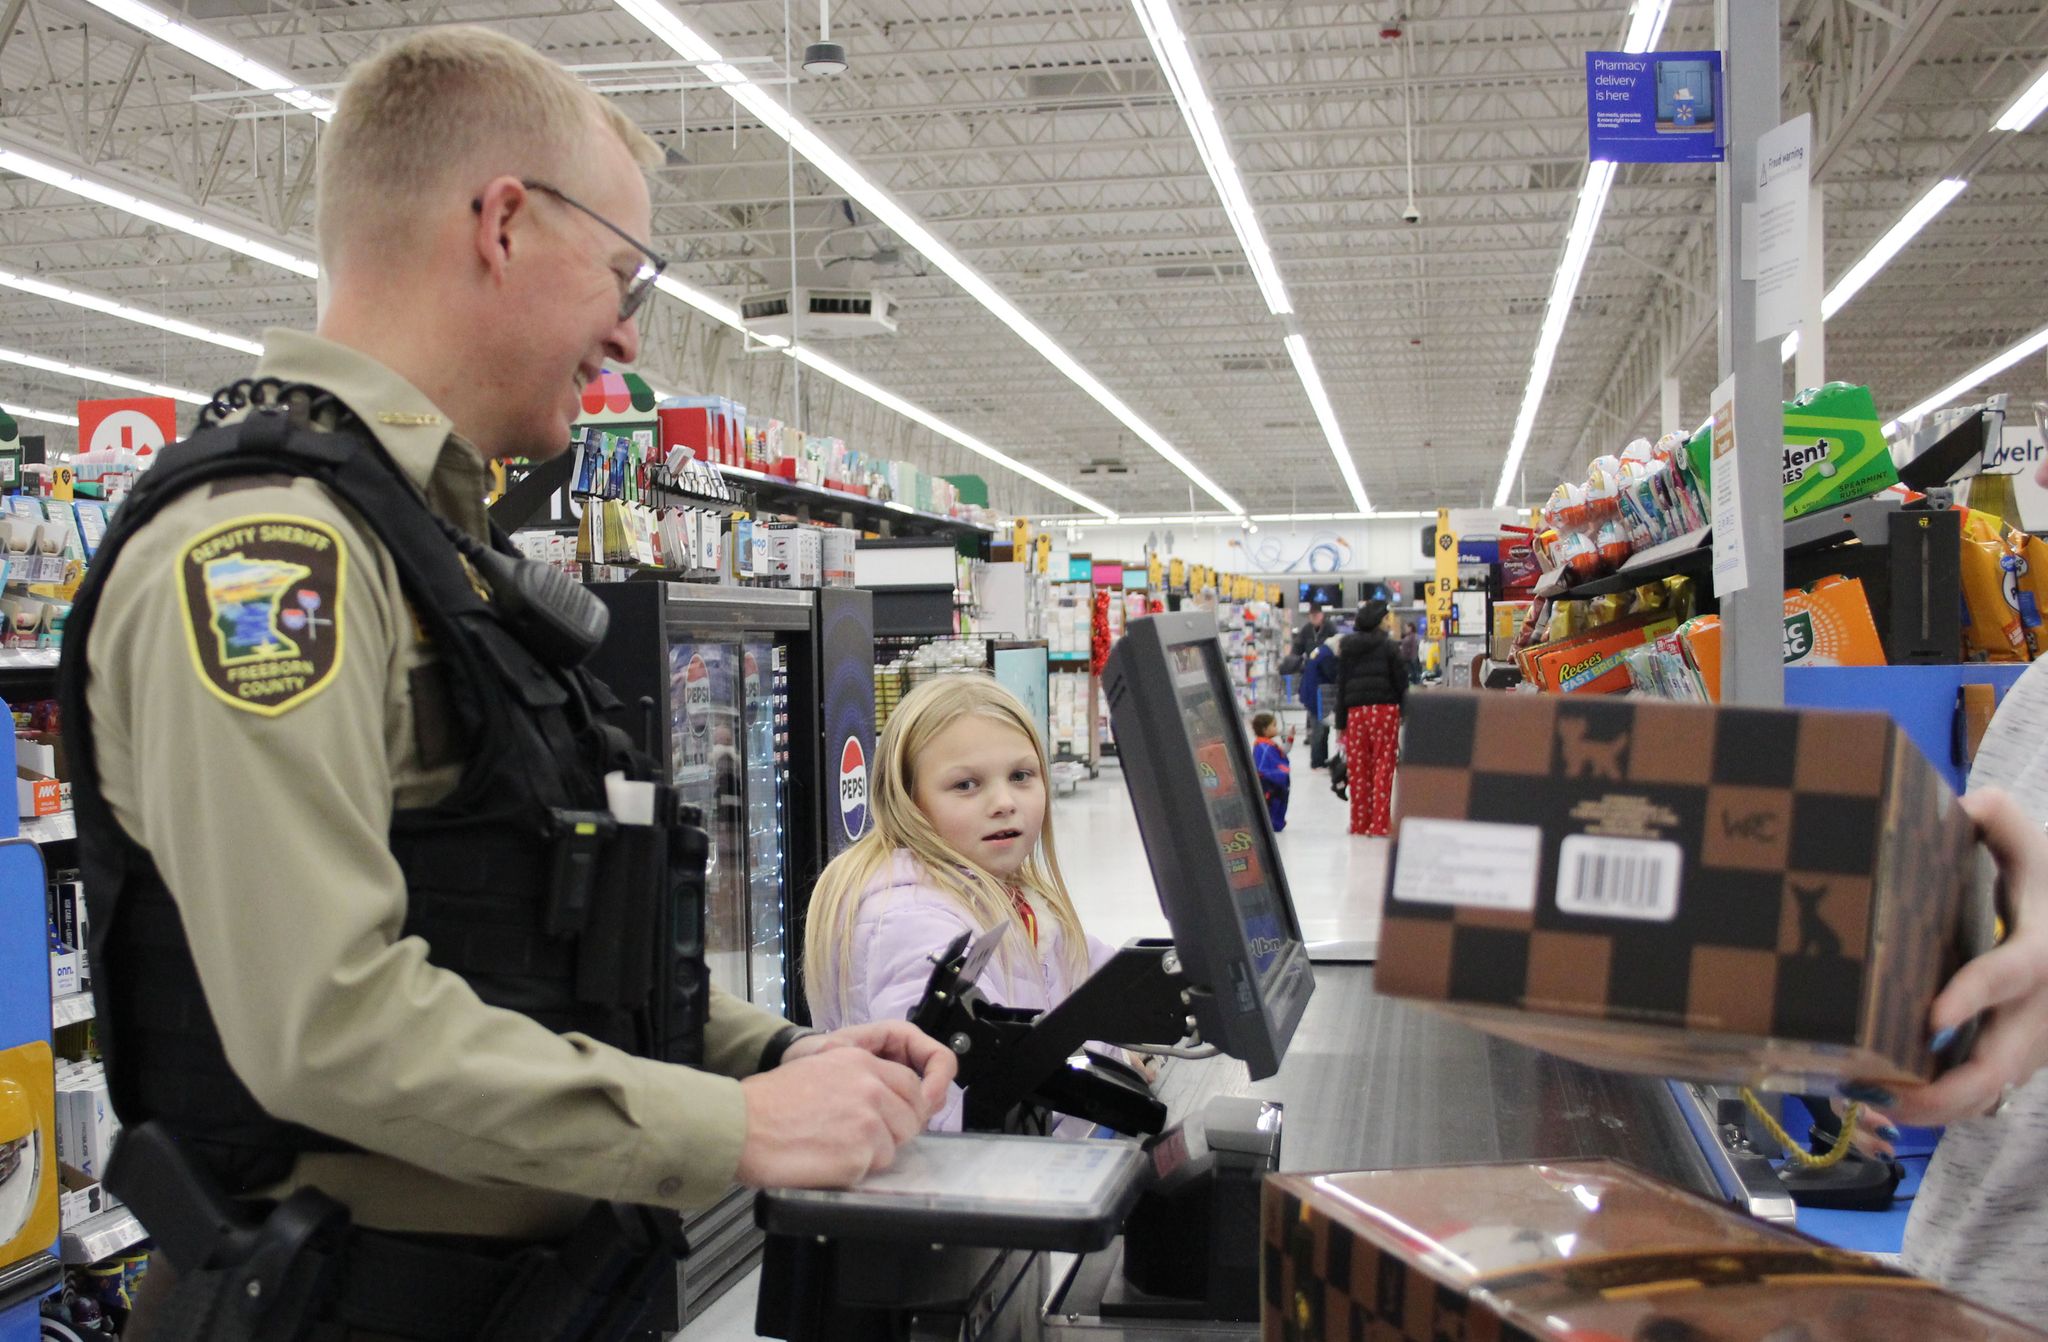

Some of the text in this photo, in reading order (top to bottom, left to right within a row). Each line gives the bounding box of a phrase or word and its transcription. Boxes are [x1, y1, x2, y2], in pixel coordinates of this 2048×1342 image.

[1594, 59, 1647, 72] Pharmacy
[1595, 75, 1636, 87] delivery
[1596, 90, 1630, 100] is here
[1768, 146, 1804, 168] Fraud warning
[1840, 471, 1888, 492] SPEARMINT
[1840, 487, 1863, 499] RUSH
[191, 525, 331, 564] DEPUTY SHERIFF
[1441, 577, 1450, 592] B
[1429, 613, 1437, 624] B
[227, 660, 315, 683] FREEBORN
[1559, 652, 1602, 683] Reese's
[1562, 655, 1625, 692] FAST BREA
[239, 676, 306, 698] COUNTY
[687, 687, 710, 704] PEPSI
[38, 785, 57, 799] MK
[842, 776, 866, 801] PEPSI
